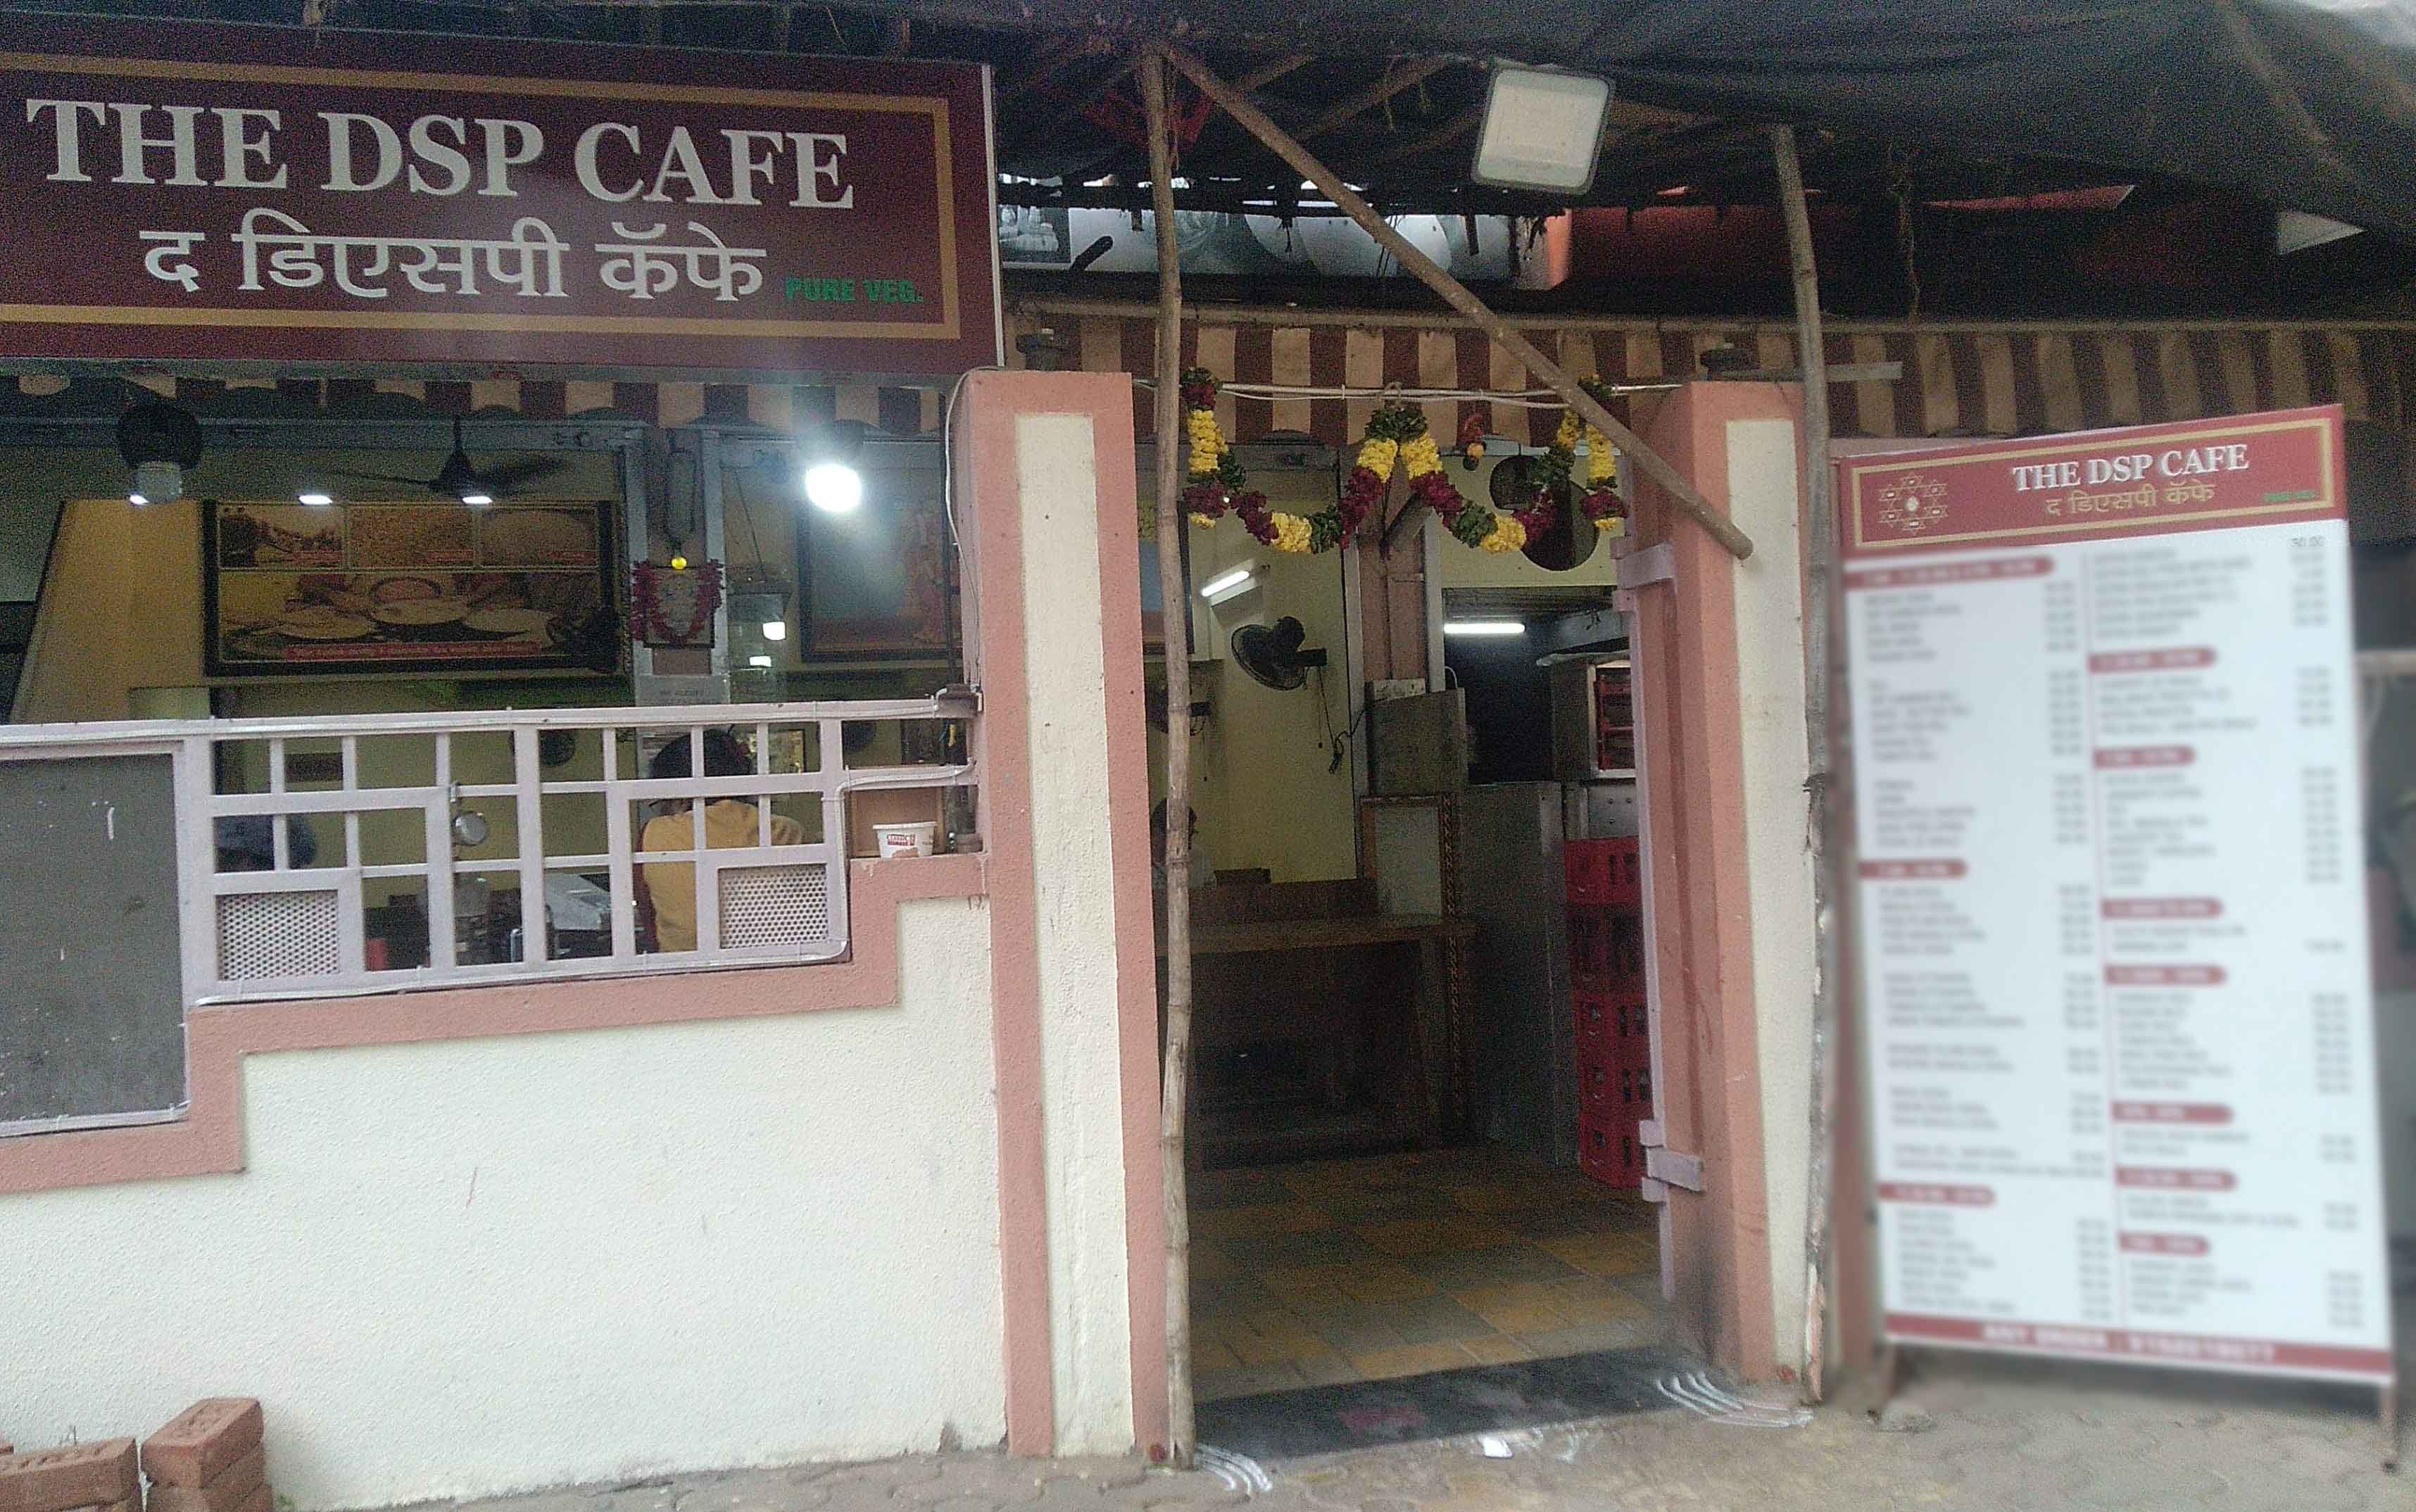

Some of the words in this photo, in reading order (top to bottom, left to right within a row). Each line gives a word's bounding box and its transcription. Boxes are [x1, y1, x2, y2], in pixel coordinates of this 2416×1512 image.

[26, 99, 288, 189] THE
[317, 112, 544, 198] DSP
[574, 123, 855, 209] CAFE
[139, 231, 204, 293] द
[232, 207, 570, 297] डिएसपी
[595, 220, 768, 301] कॅफे
[784, 277, 856, 303] PURE
[2013, 462, 2081, 491] THE
[2088, 454, 2153, 484] DSP
[2159, 444, 2250, 477] CAFE
[2045, 496, 2062, 517] द
